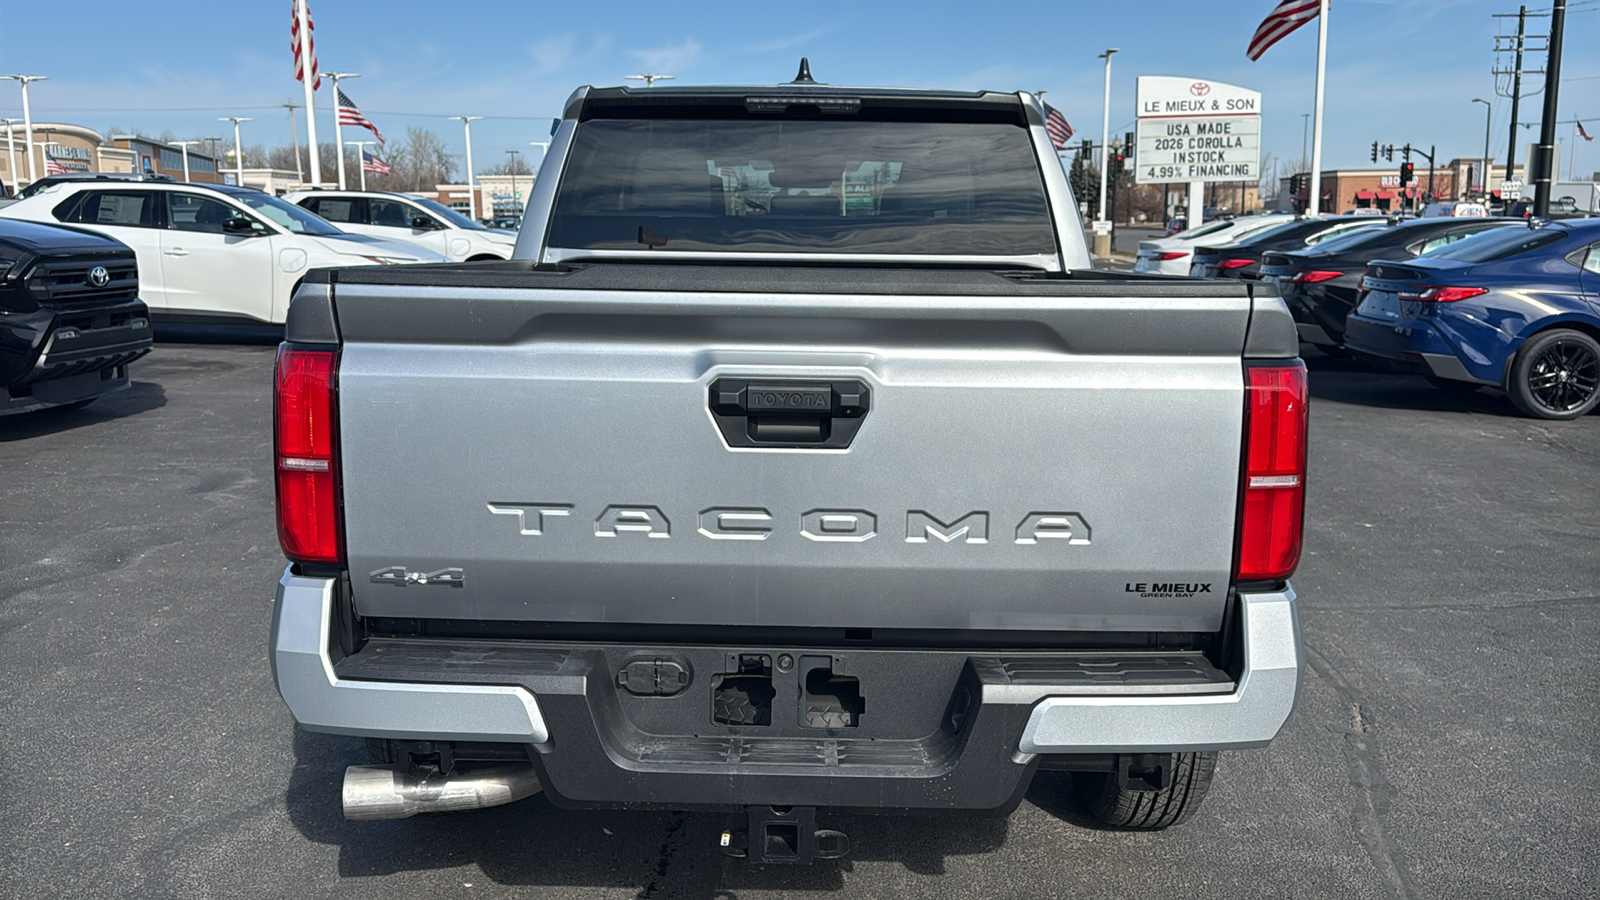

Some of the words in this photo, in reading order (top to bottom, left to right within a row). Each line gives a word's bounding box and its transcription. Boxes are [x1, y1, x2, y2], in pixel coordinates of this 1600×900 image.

[1144, 101, 1160, 113] LE
[1165, 100, 1206, 112] MIEUX
[1211, 100, 1220, 111] &
[1226, 98, 1255, 110] SON
[1167, 124, 1190, 136] USA
[1197, 122, 1231, 135] MADE
[1155, 138, 1183, 151] 2026
[1188, 136, 1242, 150] COROLLA
[1147, 165, 1183, 179] 4.99%
[1188, 164, 1249, 177] FINANCING
[751, 392, 827, 407] TOYOTA
[486, 502, 1092, 545] TACOMA
[1125, 583, 1147, 592] LE
[1152, 583, 1212, 593] MIEUX
